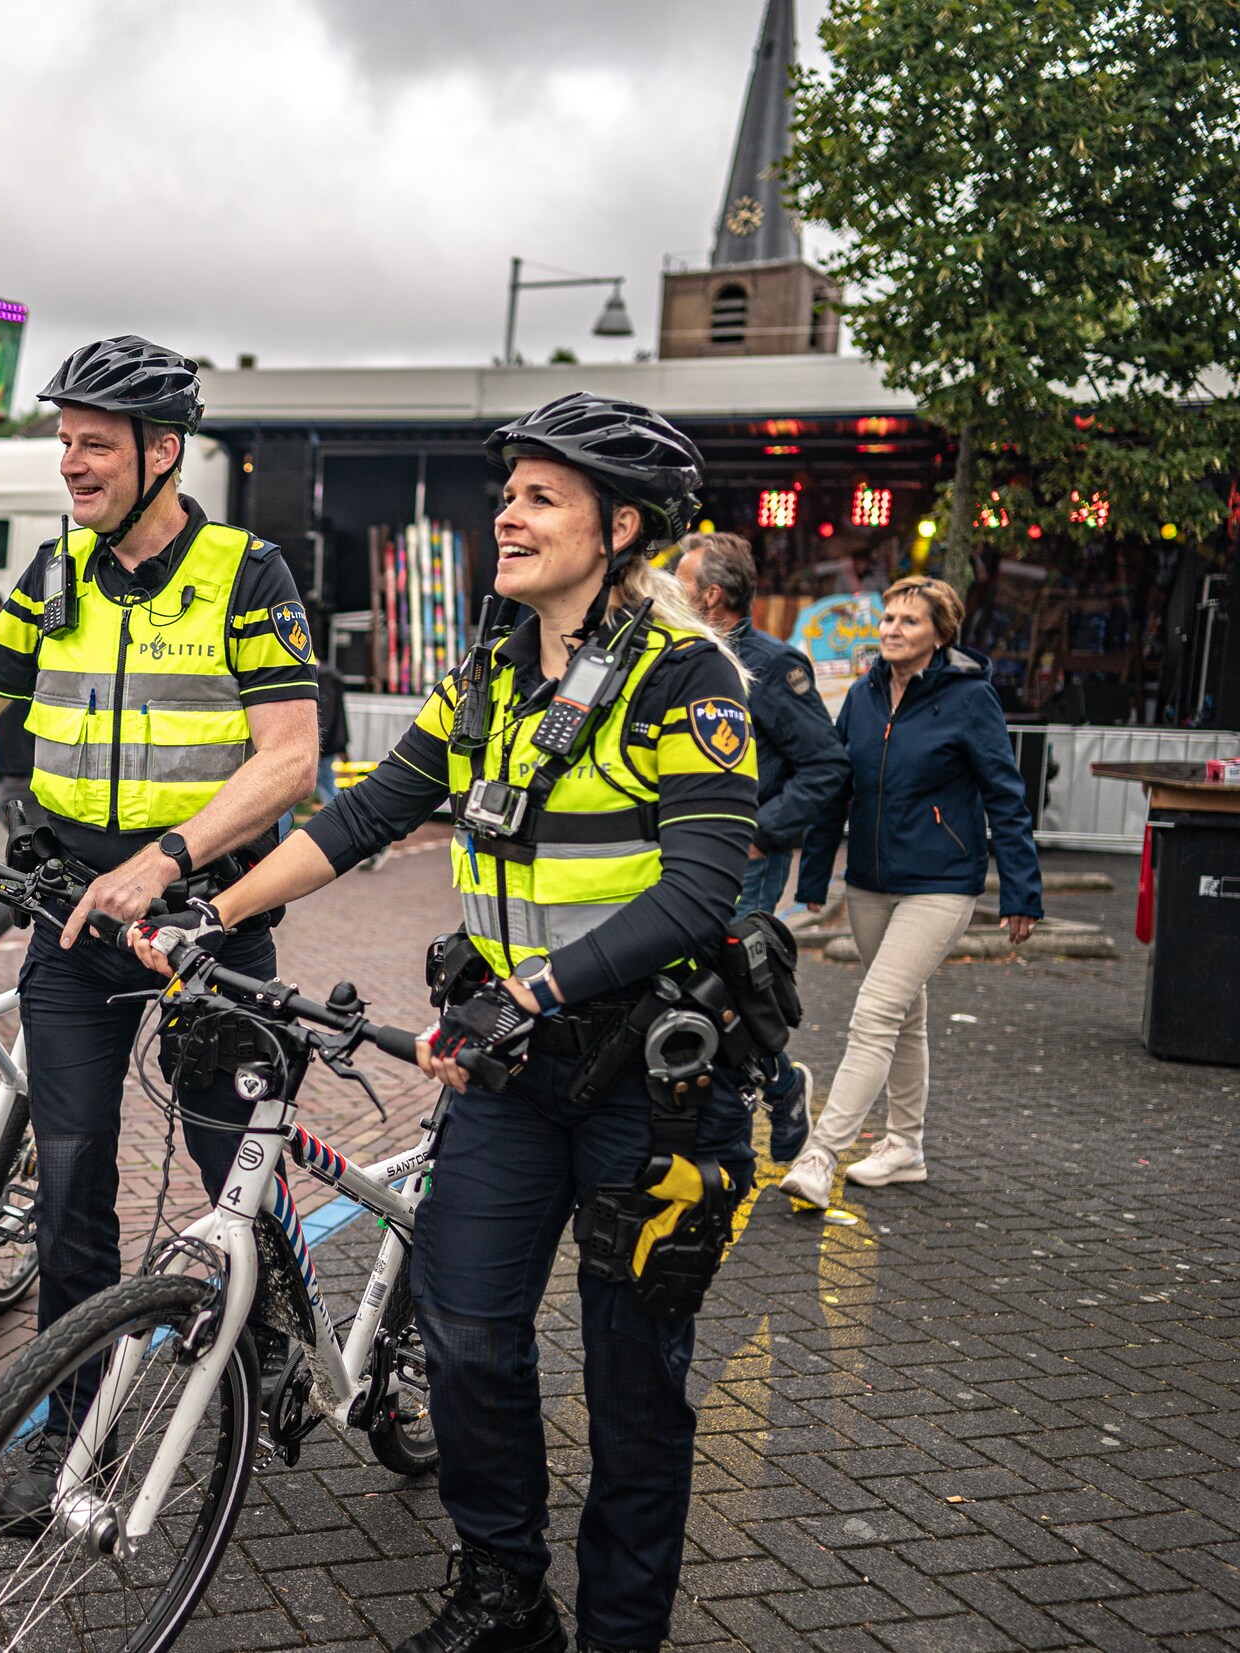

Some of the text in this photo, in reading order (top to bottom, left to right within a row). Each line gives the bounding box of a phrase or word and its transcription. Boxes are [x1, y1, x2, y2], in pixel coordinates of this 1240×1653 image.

[139, 636, 215, 660] POLITIE
[696, 705, 745, 721] POLITIE
[518, 759, 612, 779] PITIE
[748, 941, 763, 959] TQ
[226, 1185, 242, 1206] 4
